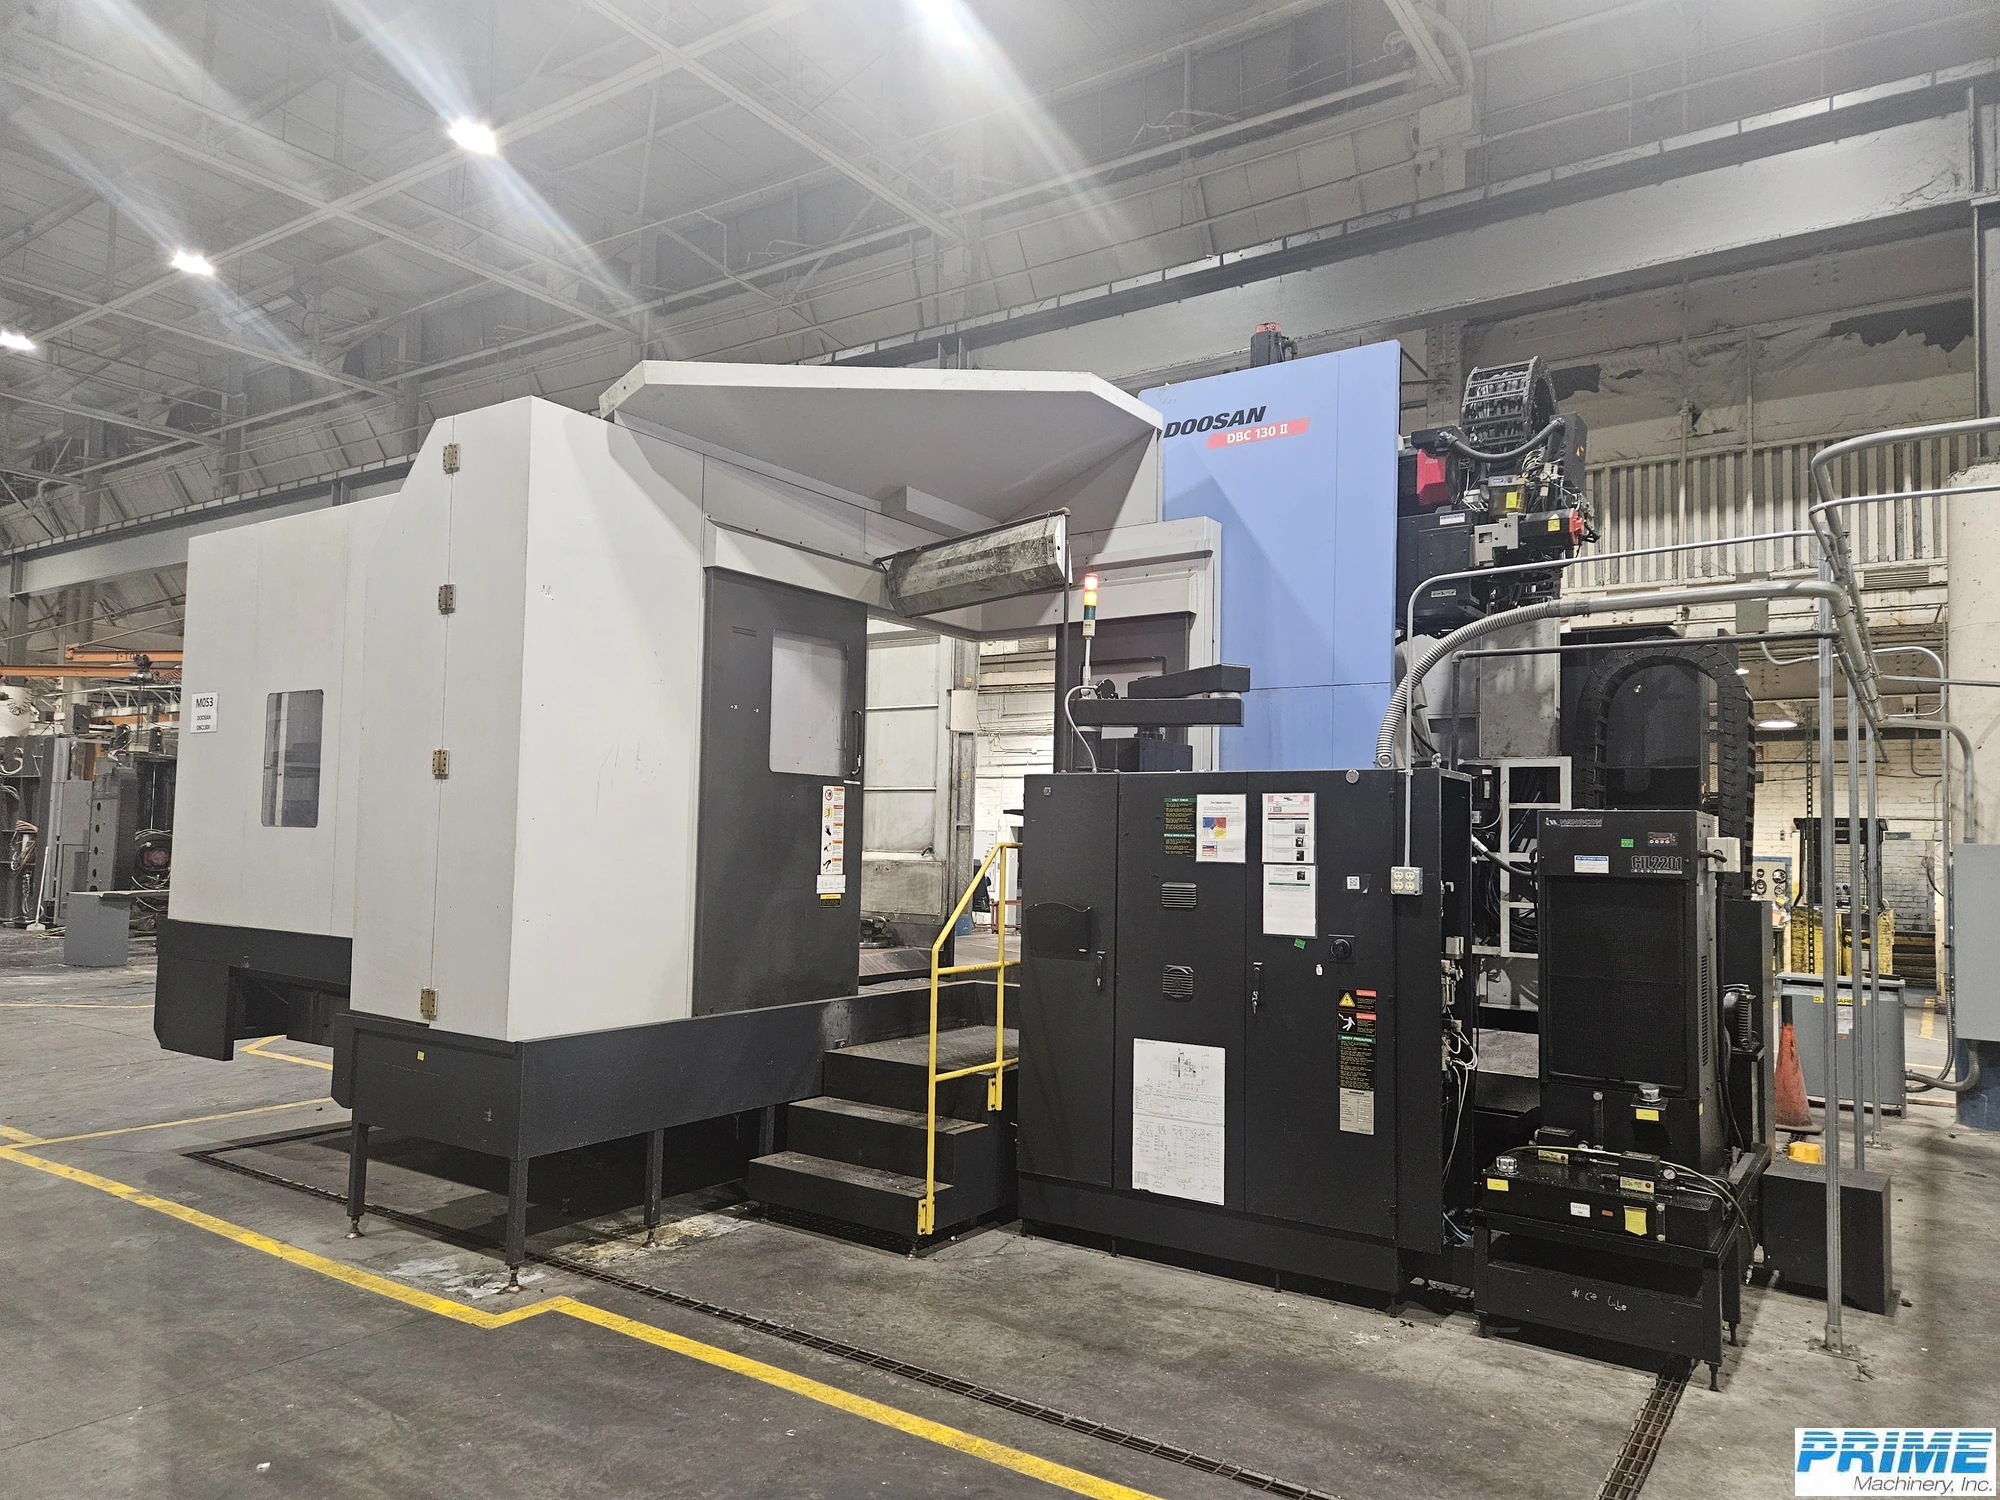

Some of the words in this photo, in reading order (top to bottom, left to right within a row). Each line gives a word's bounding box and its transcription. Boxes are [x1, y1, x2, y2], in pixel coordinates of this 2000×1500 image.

[1163, 406, 1266, 438] DOOSAN
[1227, 430, 1251, 444] DBC
[1255, 426, 1276, 439] 130
[196, 697, 213, 708] M053
